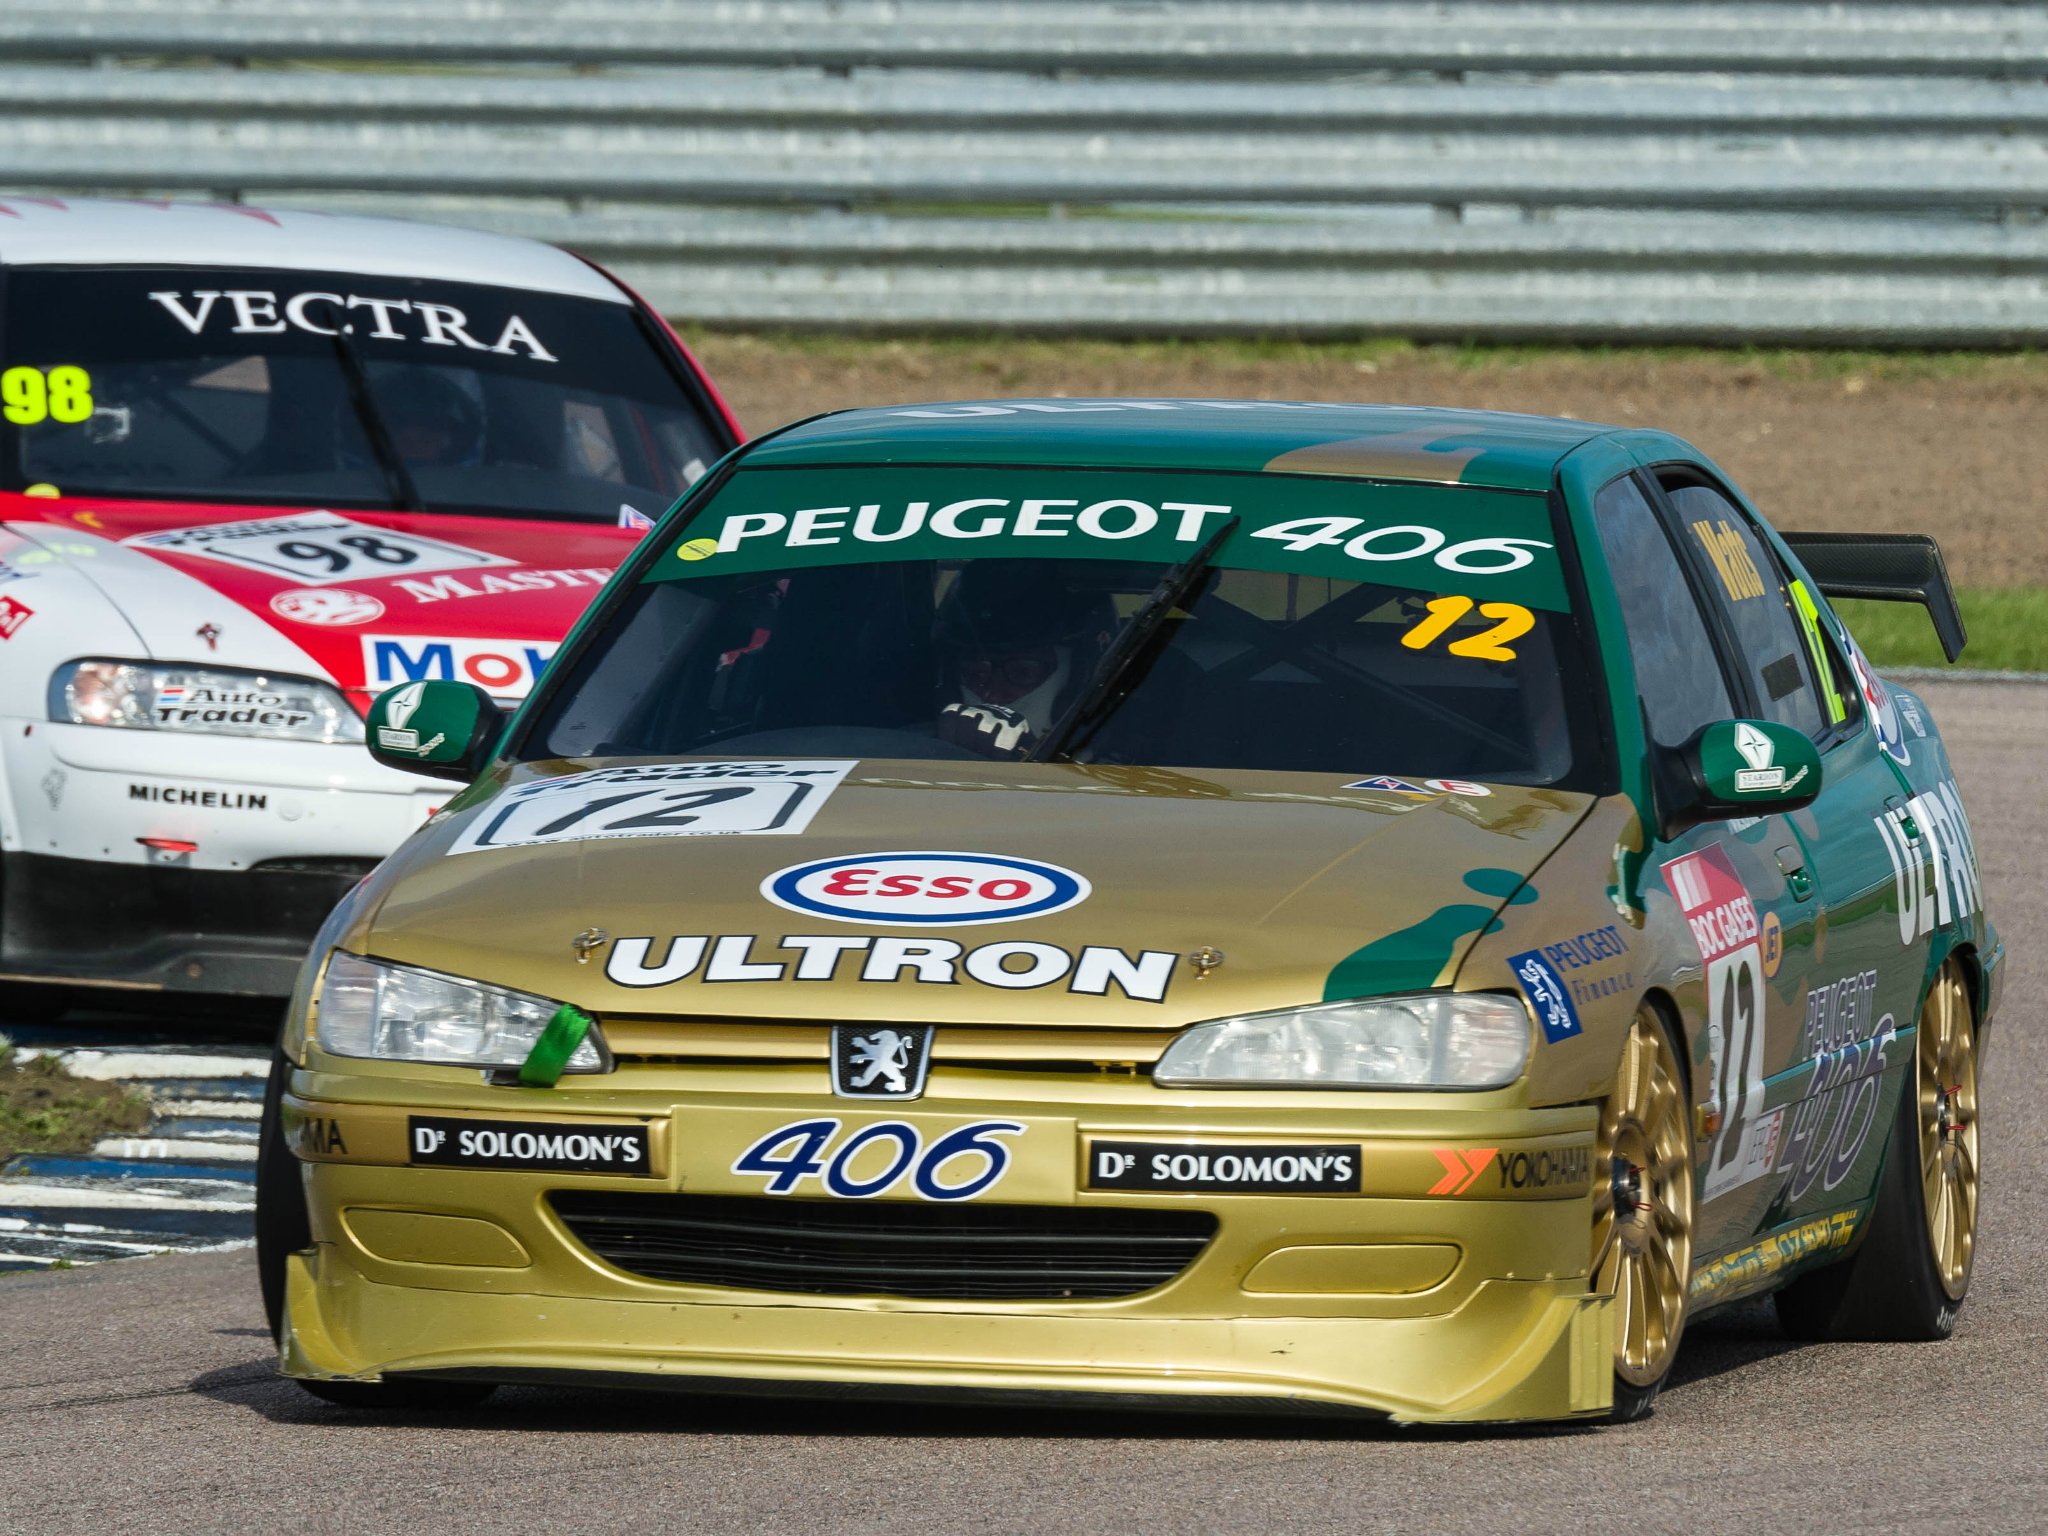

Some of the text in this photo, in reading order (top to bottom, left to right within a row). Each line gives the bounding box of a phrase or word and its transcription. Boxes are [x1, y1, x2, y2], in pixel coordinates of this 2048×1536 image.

[148, 289, 559, 363] VECTRA
[1, 365, 94, 424] 98
[276, 536, 419, 573] 98
[715, 498, 1554, 574] PEUGEOT 406
[1400, 595, 1536, 662] 12
[157, 707, 309, 727] Trader
[185, 689, 282, 706] Auto
[129, 783, 268, 811] MICHELIN
[535, 786, 756, 837] 12
[605, 934, 1179, 1004] ULTRON
[1543, 924, 1630, 973] PEUGEOT
[1800, 969, 1878, 1062] PEUGEOT
[1776, 1013, 1897, 1203] 406
[458, 1129, 642, 1163] SOLOMON'S
[730, 1117, 1030, 1202] 406
[1151, 1153, 1353, 1183] SOLOMON'S
